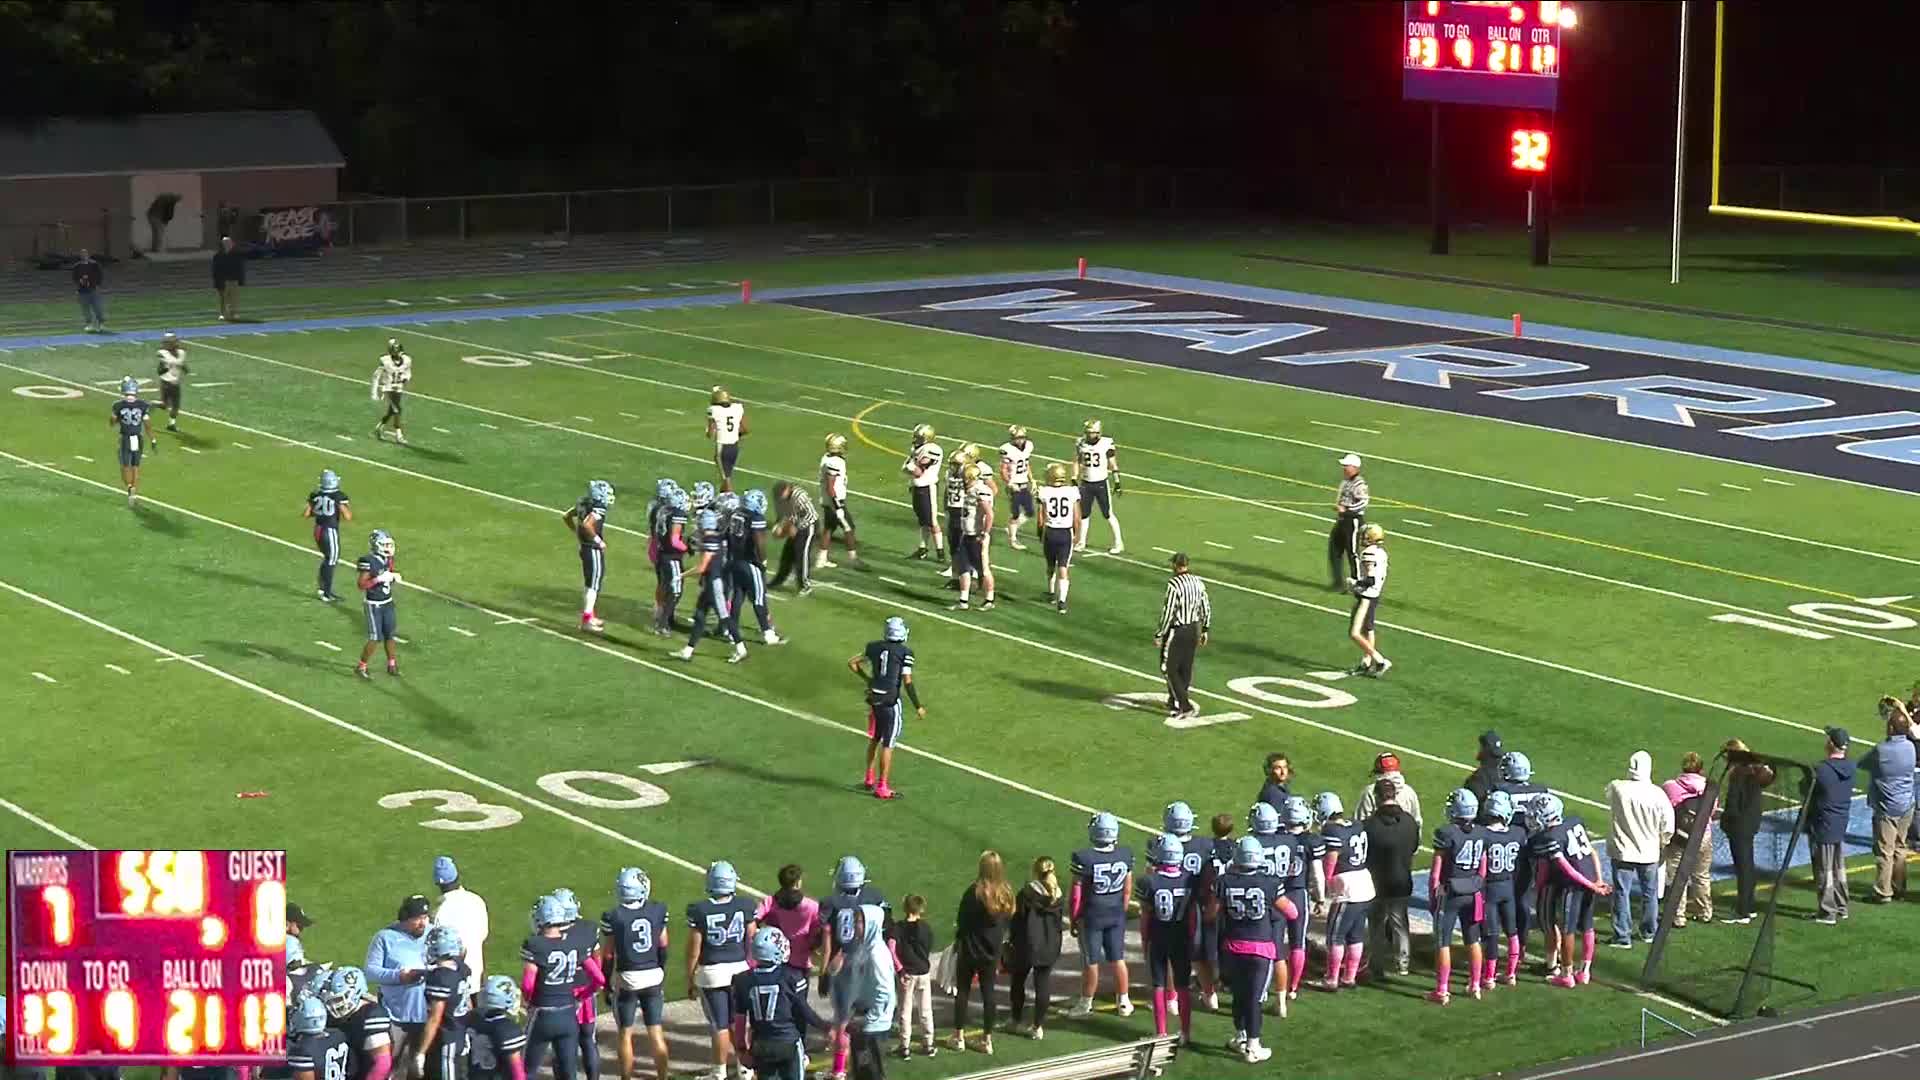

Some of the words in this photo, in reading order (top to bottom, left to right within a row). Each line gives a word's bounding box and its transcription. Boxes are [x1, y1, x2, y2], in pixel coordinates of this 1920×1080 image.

[1408, 22, 1435, 37] DOWN
[1443, 23, 1455, 38] TO
[1457, 24, 1470, 39] GO
[1488, 26, 1508, 41] BALL
[1509, 27, 1521, 42] ON
[1531, 28, 1550, 43] QTR
[1488, 40, 1521, 72] 21
[1511, 130, 1549, 171] 32
[119, 407, 142, 426] 33
[726, 416, 735, 433] 5
[1083, 452, 1101, 468] 23
[313, 495, 336, 517] 20
[1049, 497, 1069, 518] 36
[880, 650, 889, 676] 1
[1456, 839, 1483, 870] 41
[1488, 841, 1520, 874] 86
[1566, 823, 1593, 860] 43
[1093, 861, 1128, 894] 52
[1262, 844, 1291, 878] 58
[1154, 888, 1191, 921] 87
[1226, 887, 1266, 920] 53
[631, 918, 653, 953] 3
[706, 911, 745, 946] 54
[547, 950, 578, 985] 21
[750, 984, 780, 1021] 17
